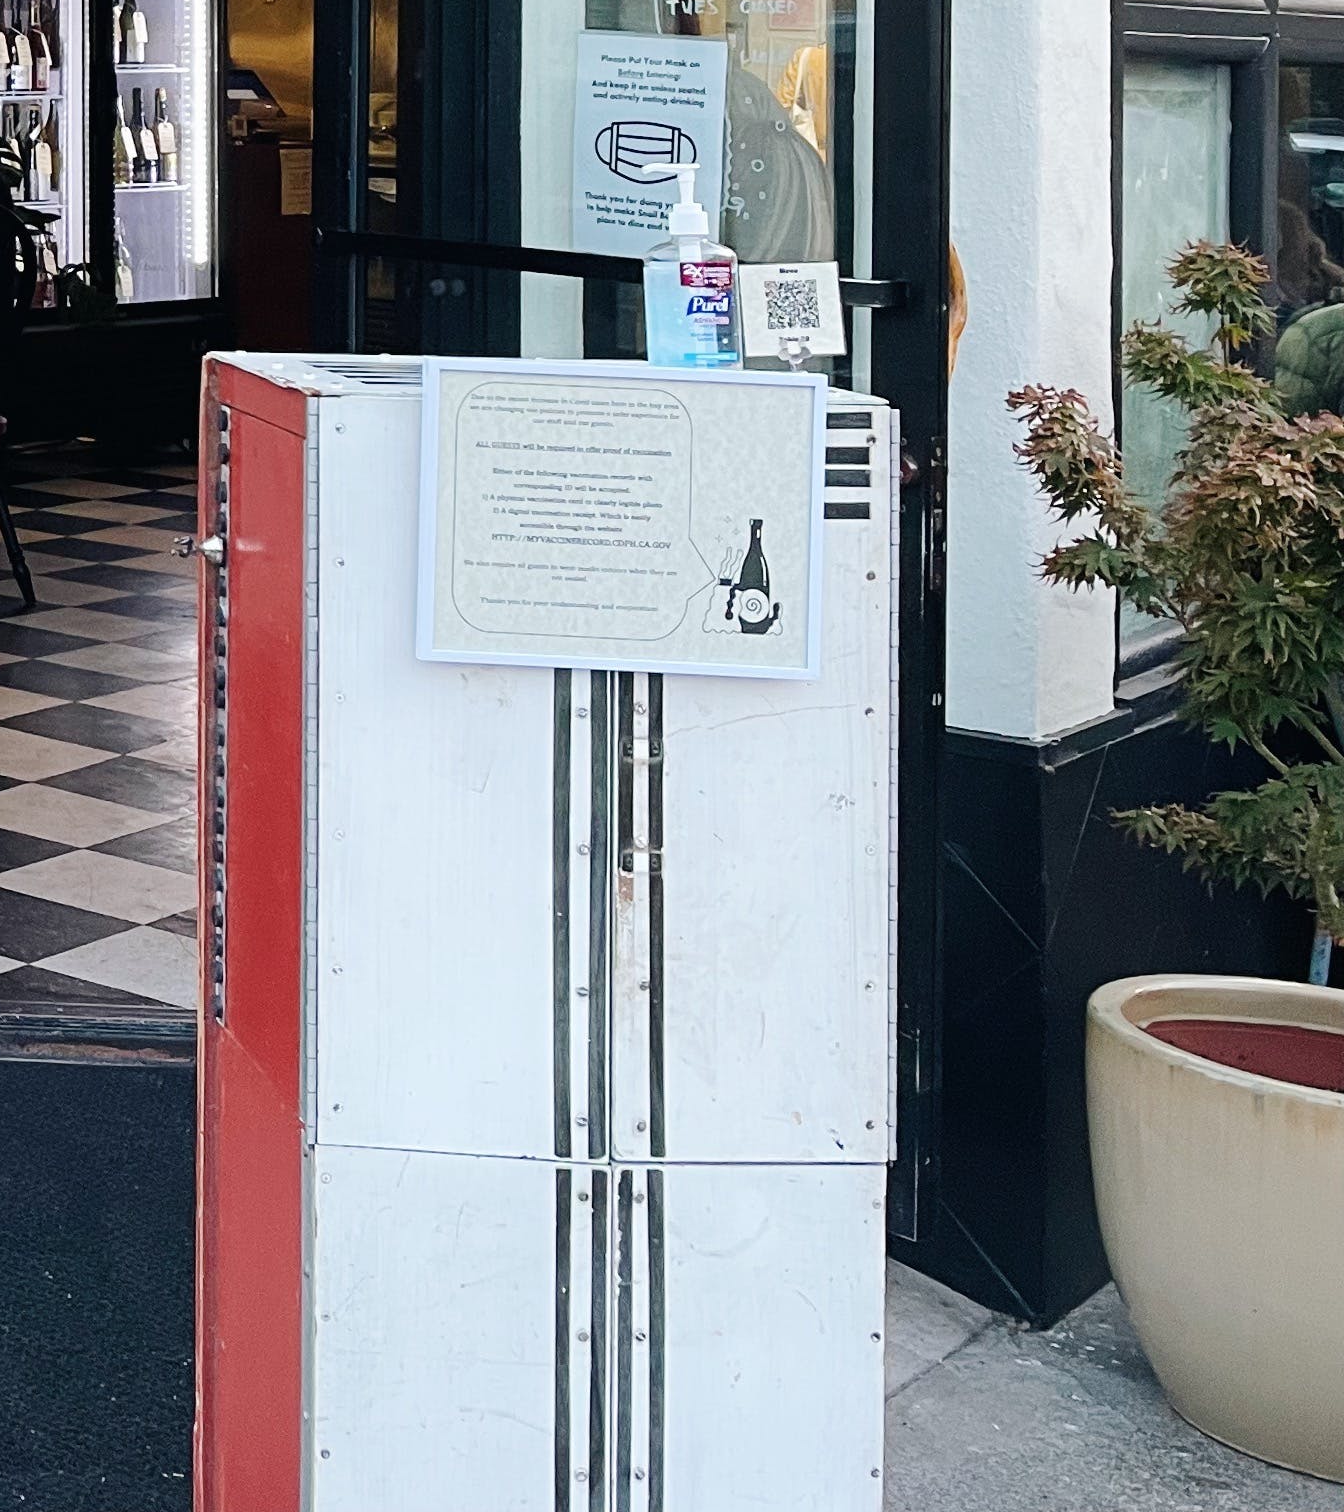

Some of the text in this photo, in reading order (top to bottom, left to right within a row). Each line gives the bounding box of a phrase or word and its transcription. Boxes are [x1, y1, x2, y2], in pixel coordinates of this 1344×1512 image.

[601, 54, 626, 63] Please
[644, 57, 662, 65] Your
[592, 80, 608, 88] And
[585, 191, 606, 201] Thank
